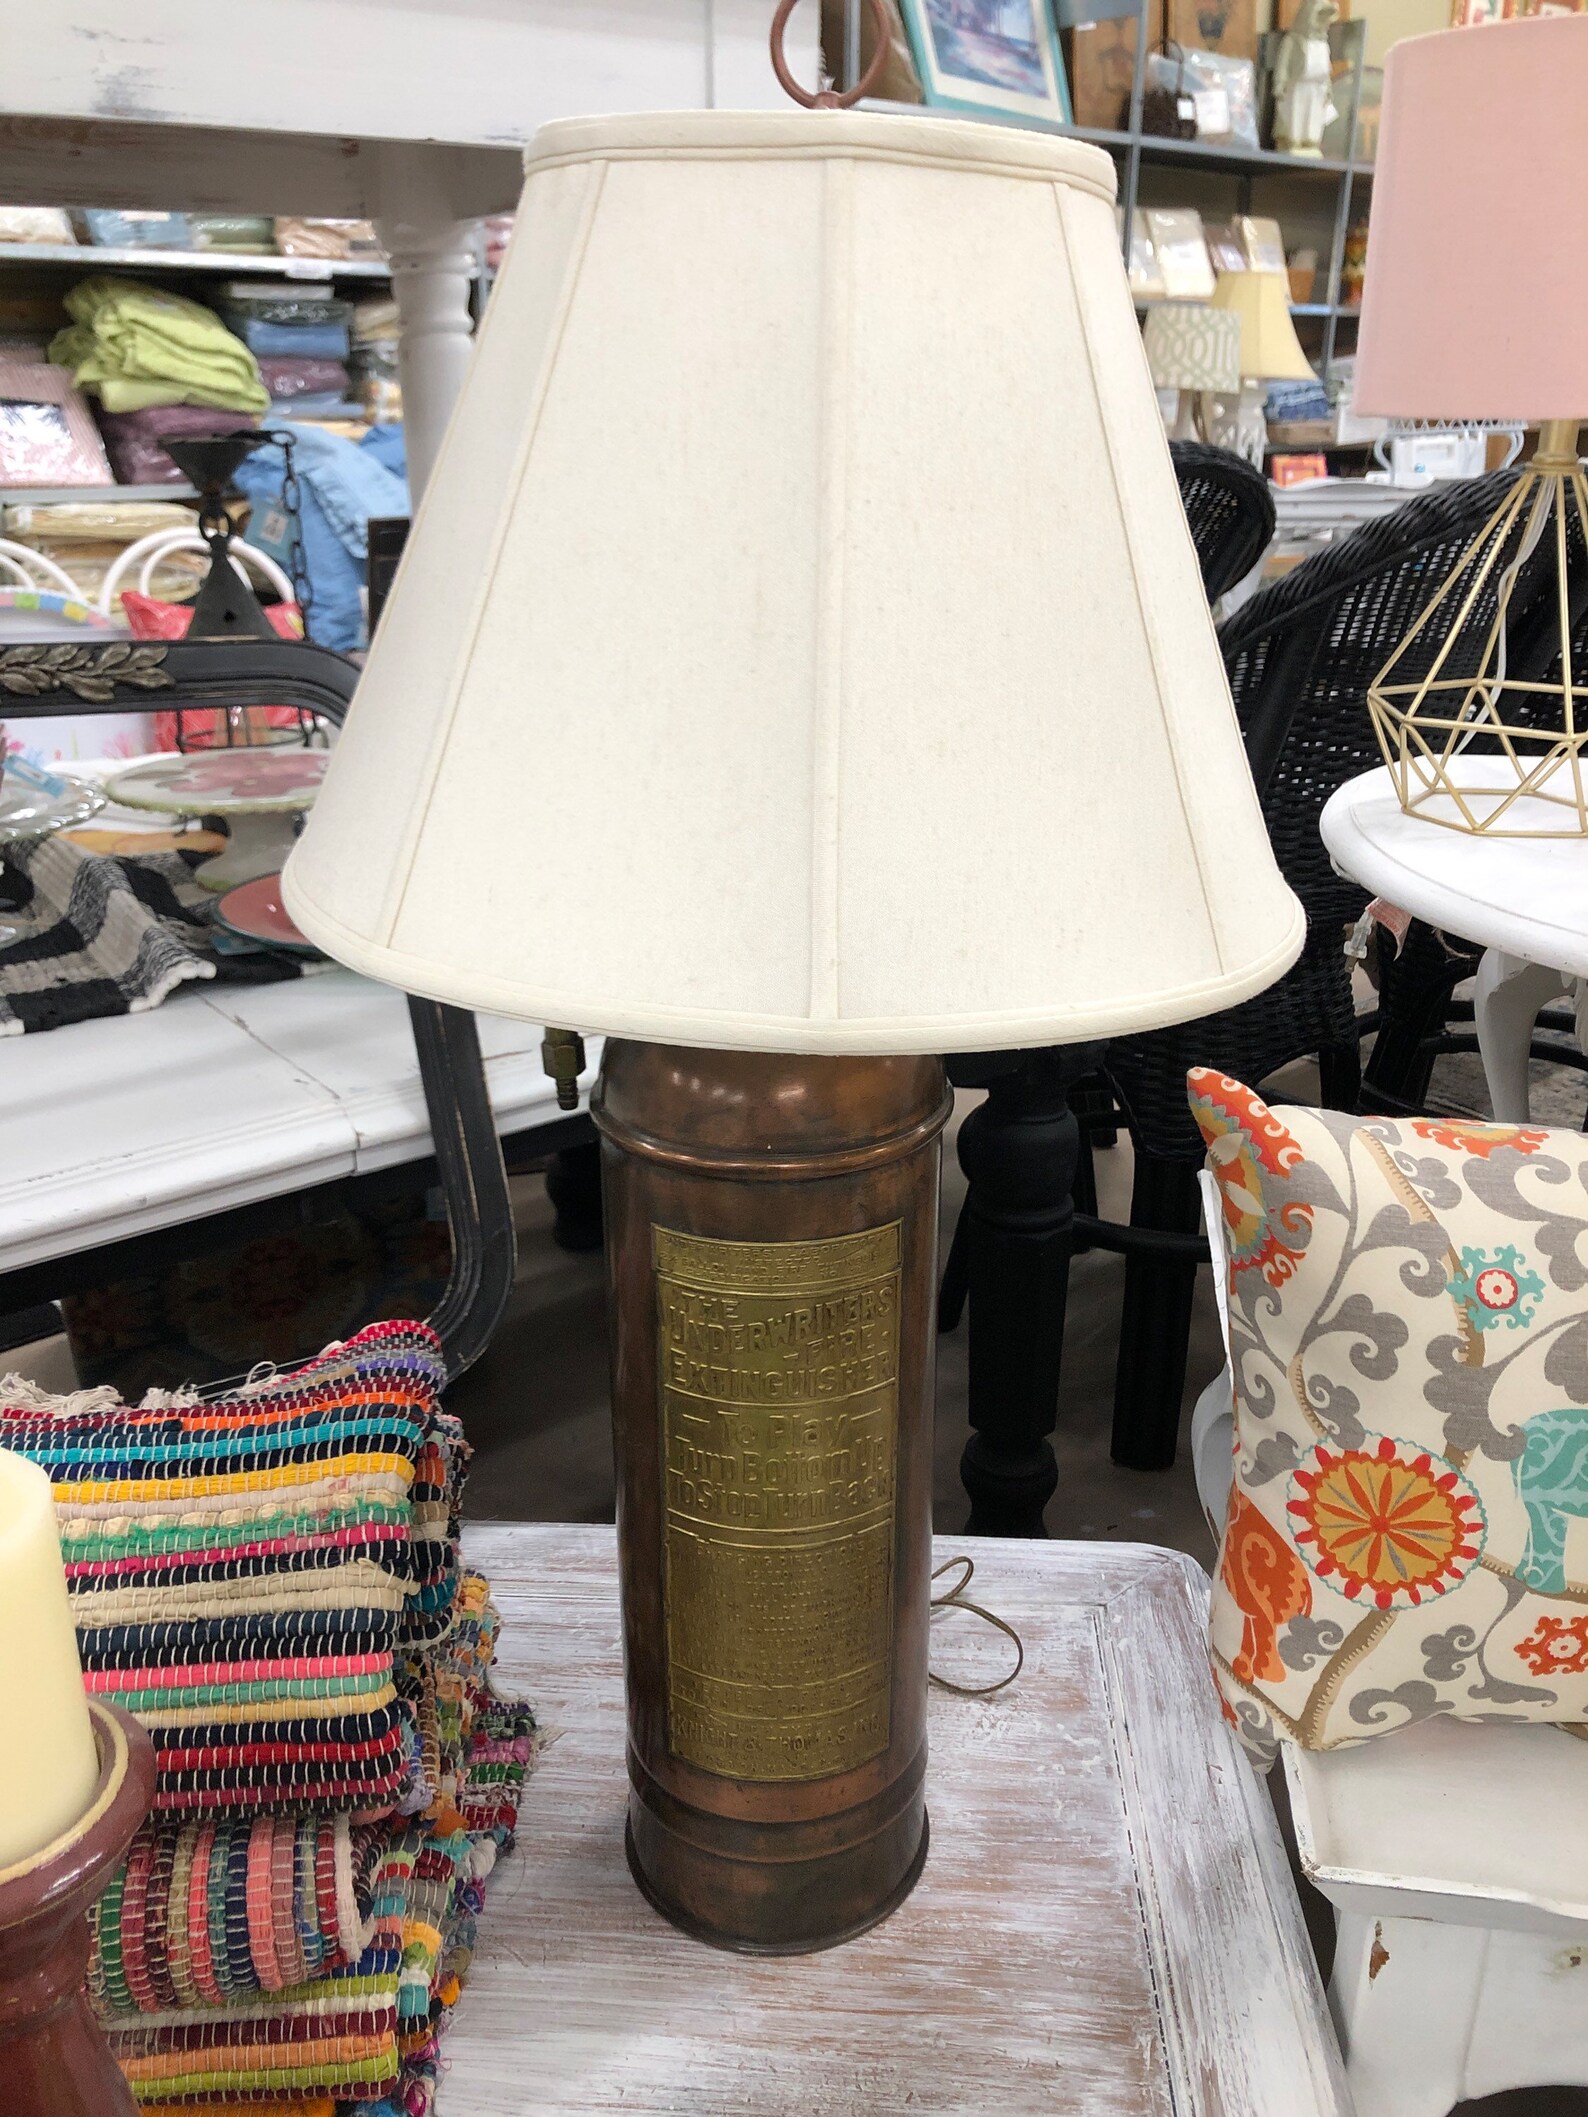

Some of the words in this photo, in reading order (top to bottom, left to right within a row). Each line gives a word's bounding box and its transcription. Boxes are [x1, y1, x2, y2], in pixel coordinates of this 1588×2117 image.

[669, 1286, 894, 1351] UNDERWRITERS
[681, 1289, 740, 1321] THE
[669, 1348, 893, 1400] EXTINGUISHER
[717, 1410, 758, 1448] To
[768, 1413, 848, 1450] Play
[675, 1434, 736, 1481] Turn
[743, 1448, 850, 1486] Bottom
[762, 1488, 825, 1520] Turn
[677, 1713, 738, 1749] KNIGHT
